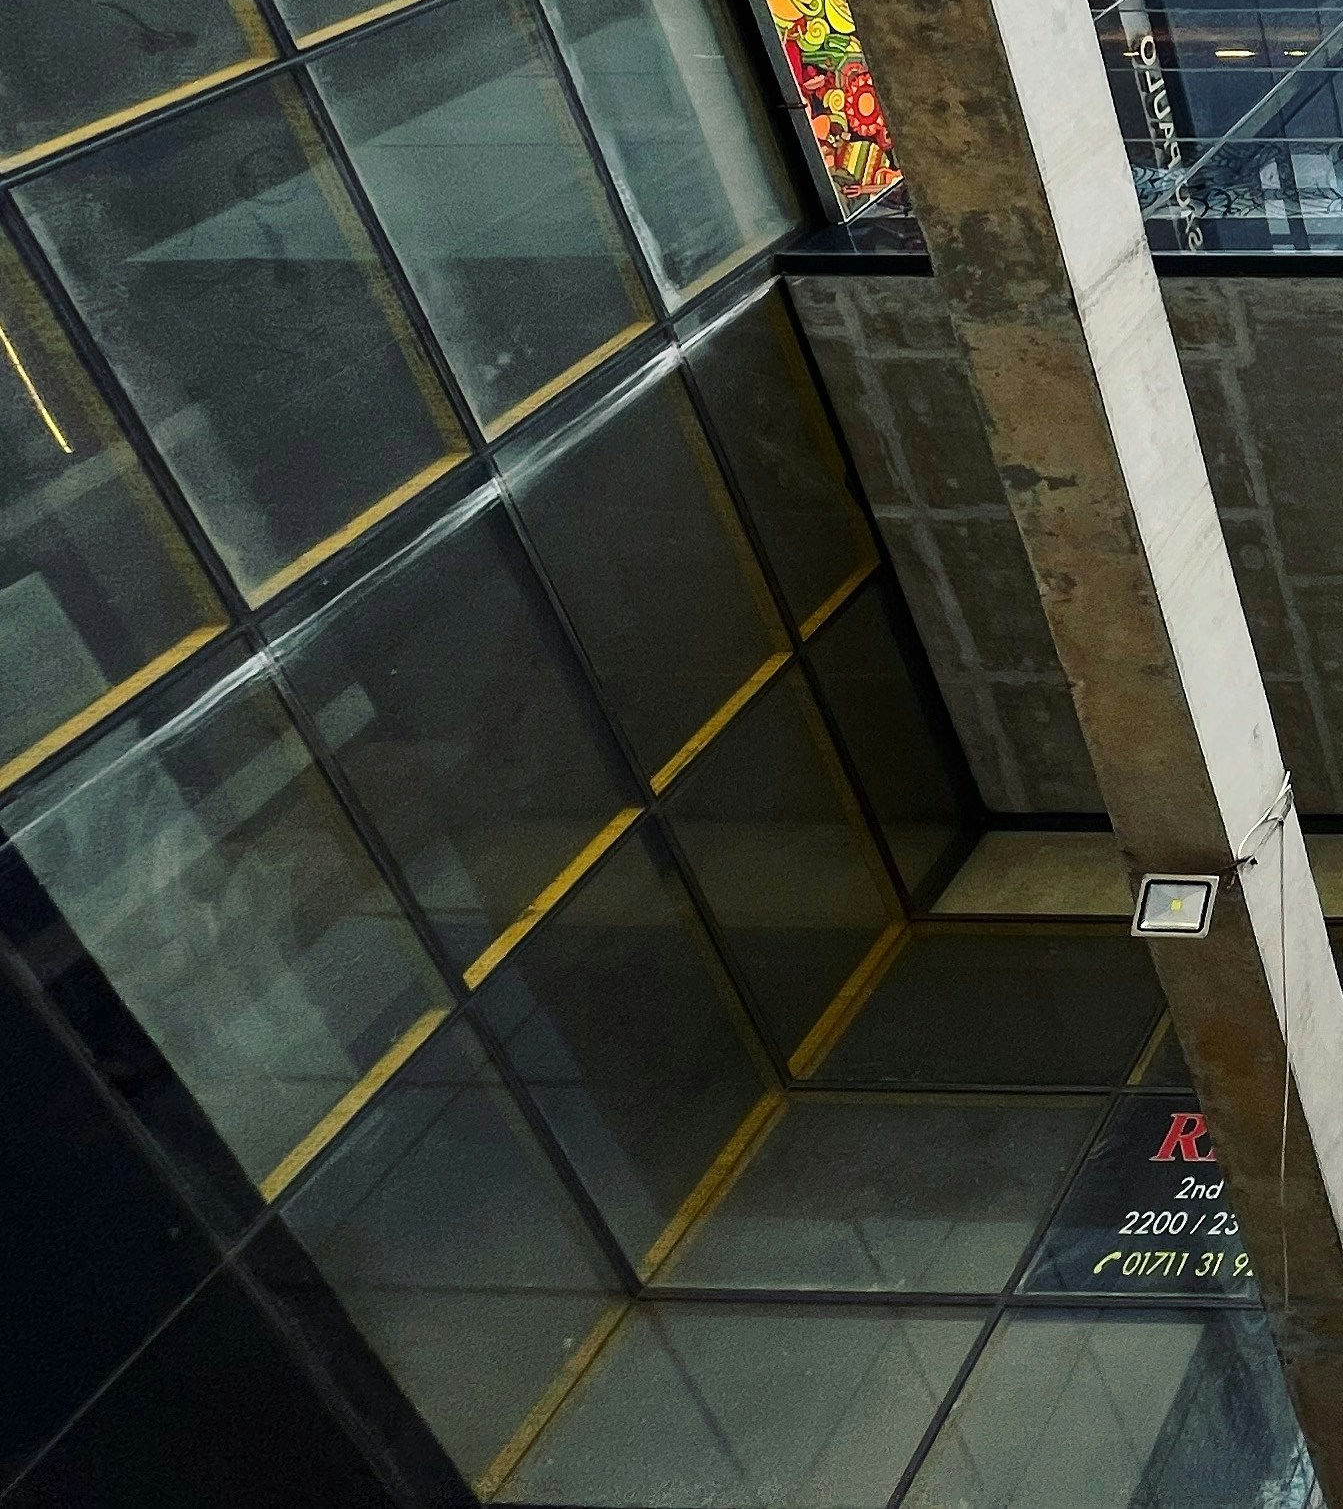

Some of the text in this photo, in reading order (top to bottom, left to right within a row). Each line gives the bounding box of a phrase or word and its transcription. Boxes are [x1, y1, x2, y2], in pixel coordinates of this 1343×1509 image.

[1149, 1113, 1217, 1162] R
[1174, 1176, 1224, 1200] 2nd
[1118, 1211, 1188, 1235] 2200
[1190, 1214, 1206, 1235] /
[1122, 1252, 1255, 1277] 01711 31 9
